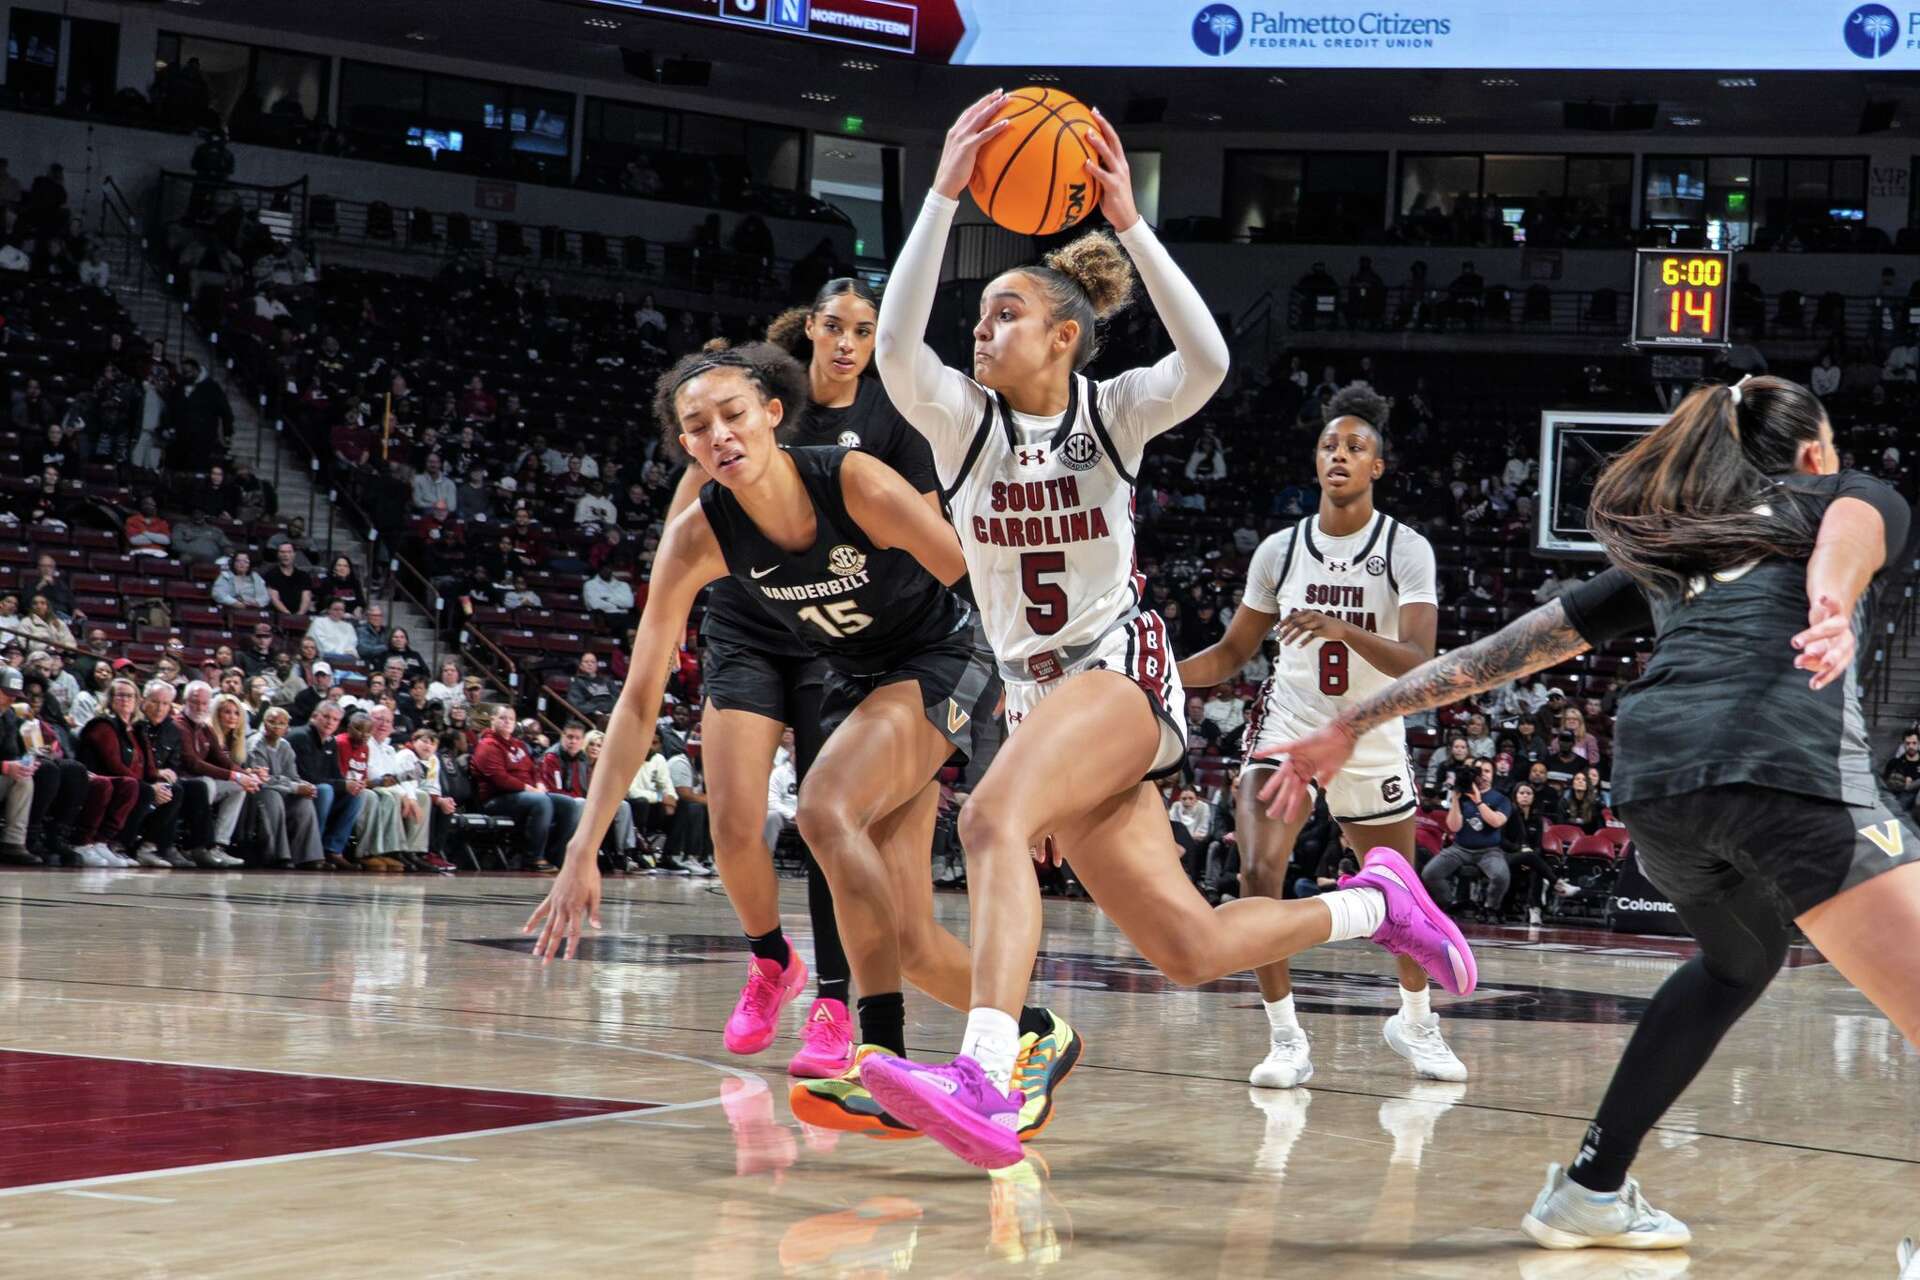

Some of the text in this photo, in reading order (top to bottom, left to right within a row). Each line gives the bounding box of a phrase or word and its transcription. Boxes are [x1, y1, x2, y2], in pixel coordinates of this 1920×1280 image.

[782, 0, 799, 22] N
[810, 8, 910, 37] NORTHWESTERN
[1250, 11, 1450, 35] Palmetto Citizens
[1250, 38, 1433, 48] FEDERAL CREDIT UNION
[1662, 259, 1722, 286] 6:00
[1669, 290, 1713, 333] 14
[1066, 434, 1094, 461] SEC
[991, 475, 1080, 513] SOUTH
[972, 507, 1110, 548] CAROLINA
[831, 546, 858, 569] SEC
[761, 570, 871, 600] VANDERBILT
[1020, 551, 1068, 636] 5
[1305, 583, 1364, 608] SOUTH
[797, 600, 874, 638] 15
[1319, 641, 1349, 696] 8
[947, 697, 970, 734] V
[1858, 819, 1905, 857] V
